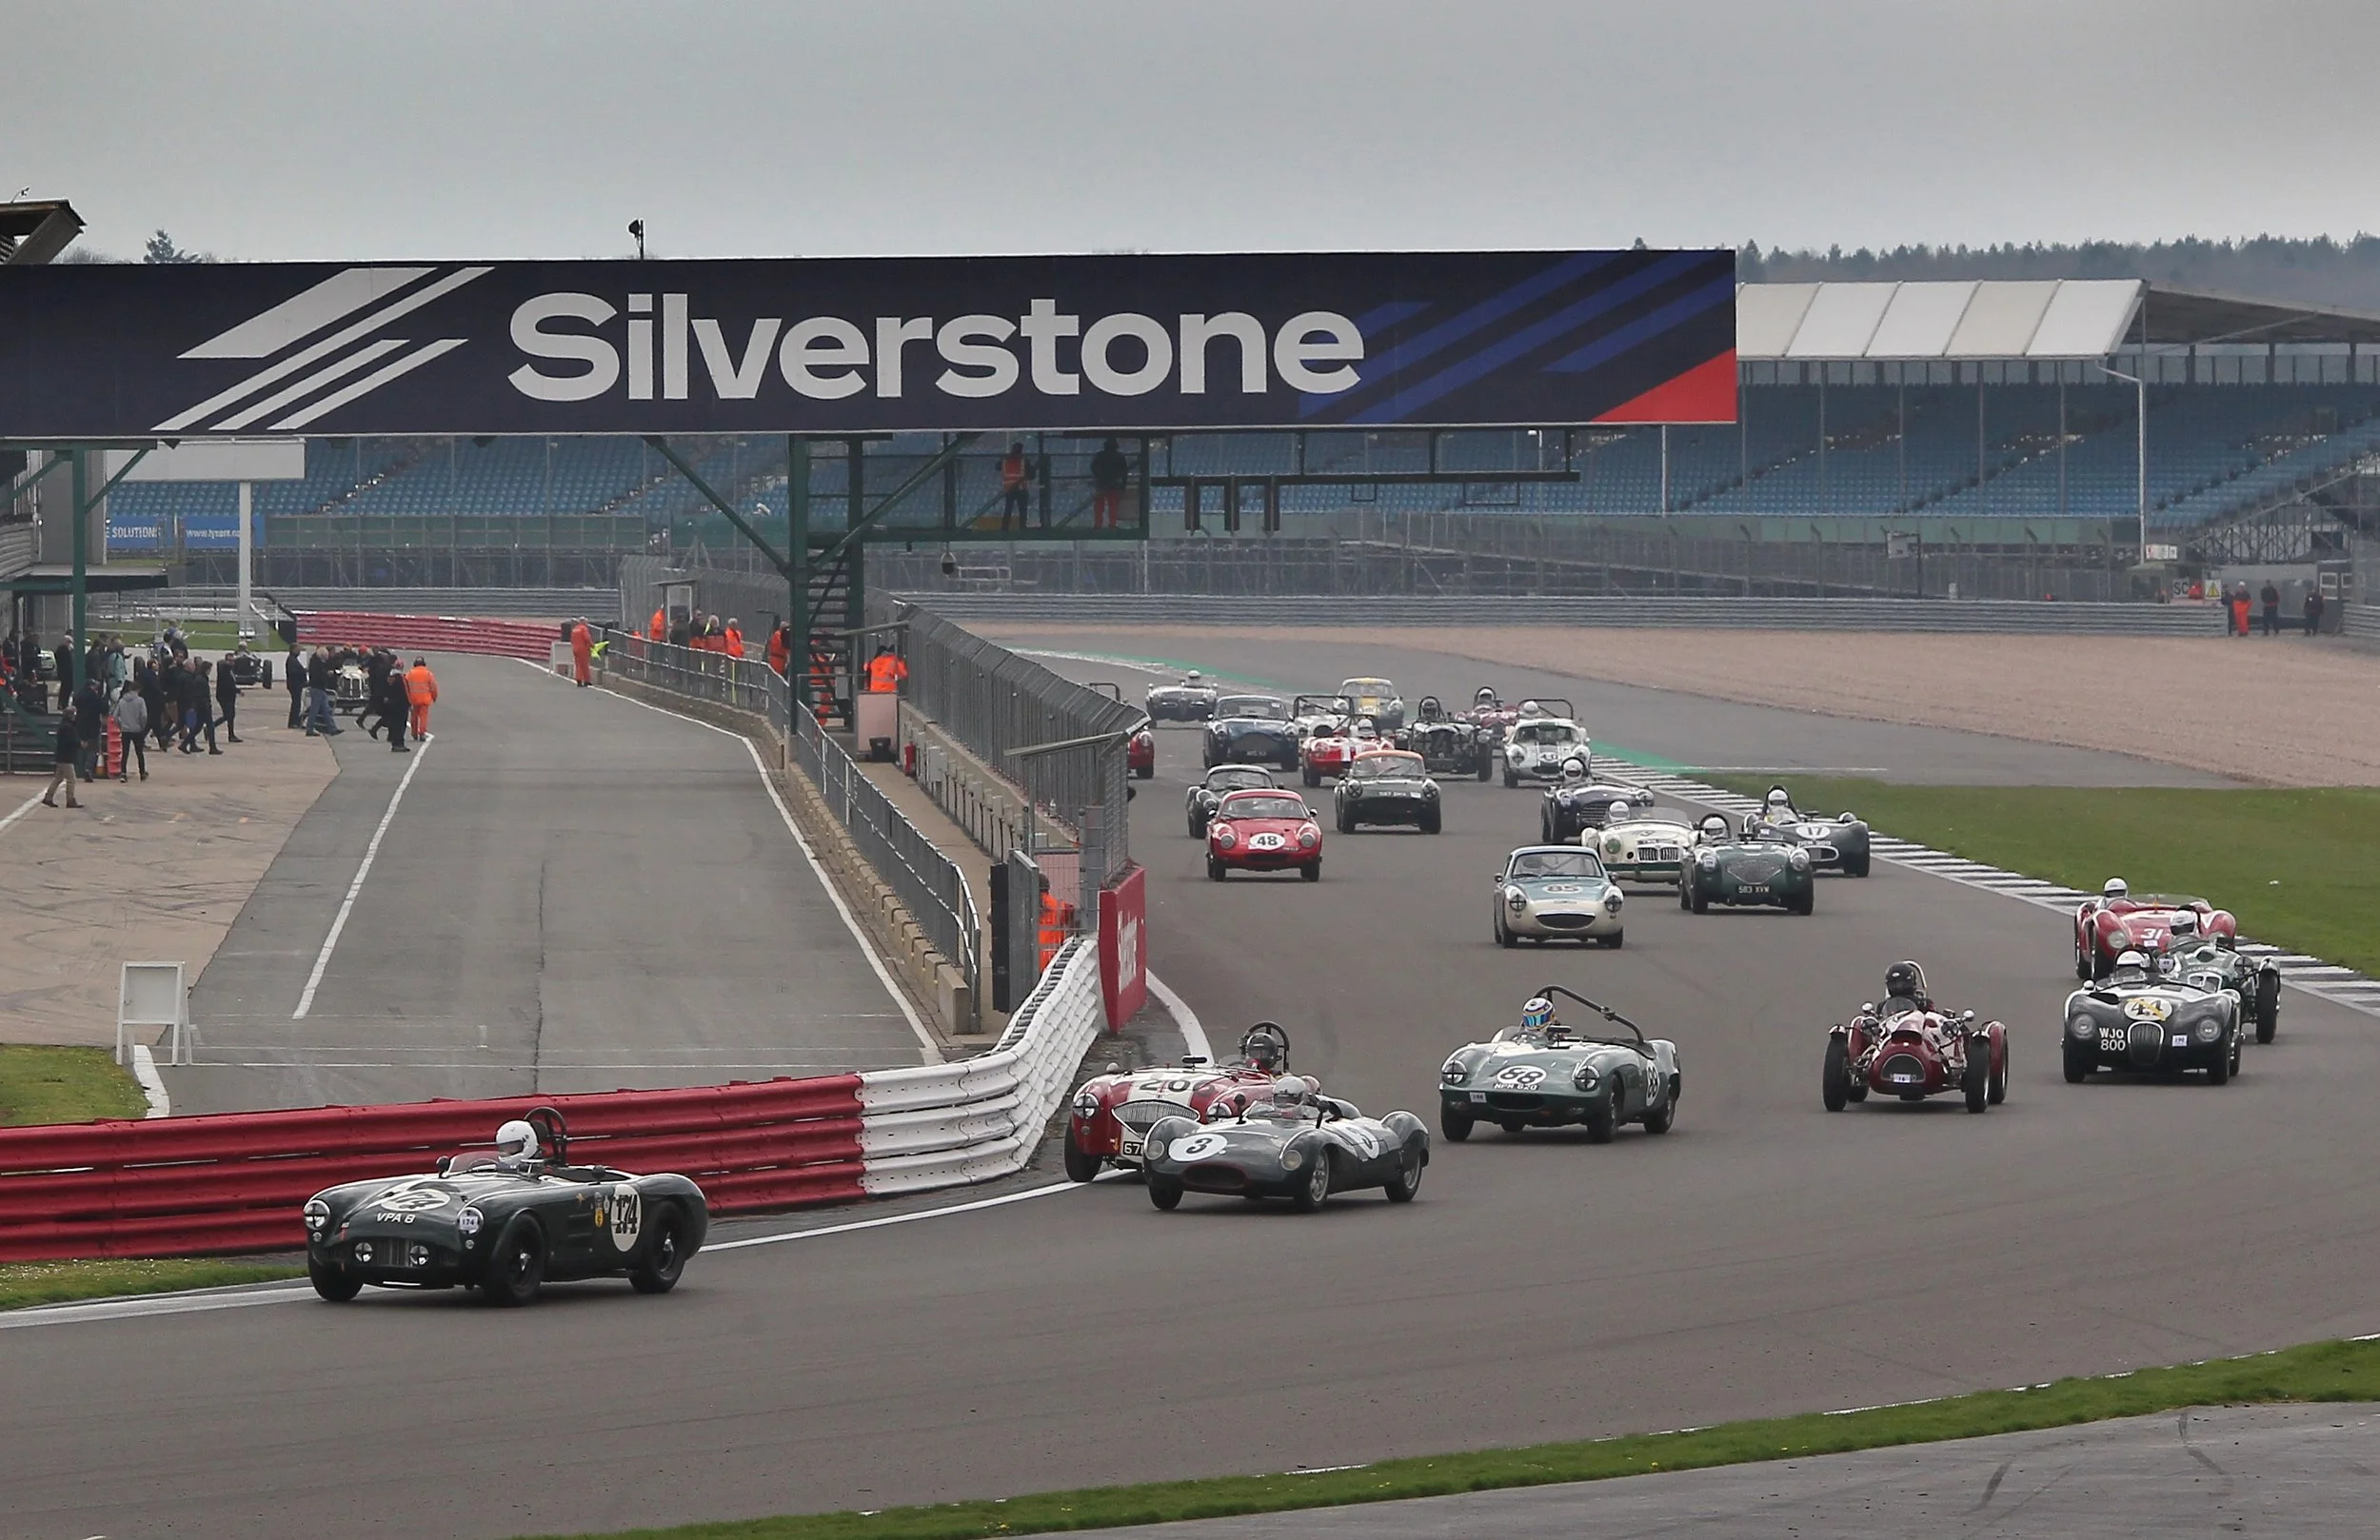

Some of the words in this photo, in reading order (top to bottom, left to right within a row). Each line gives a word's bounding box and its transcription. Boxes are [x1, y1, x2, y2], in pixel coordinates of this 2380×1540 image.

[508, 292, 1364, 402] Silverstone
[1807, 826, 1823, 836] 17
[1257, 836, 1278, 846] 48
[2140, 927, 2164, 940] 31
[2098, 1027, 2124, 1039] WJO
[2100, 1038, 2126, 1051] 800
[1186, 1137, 1213, 1154] 3
[376, 1213, 402, 1222] VPA
